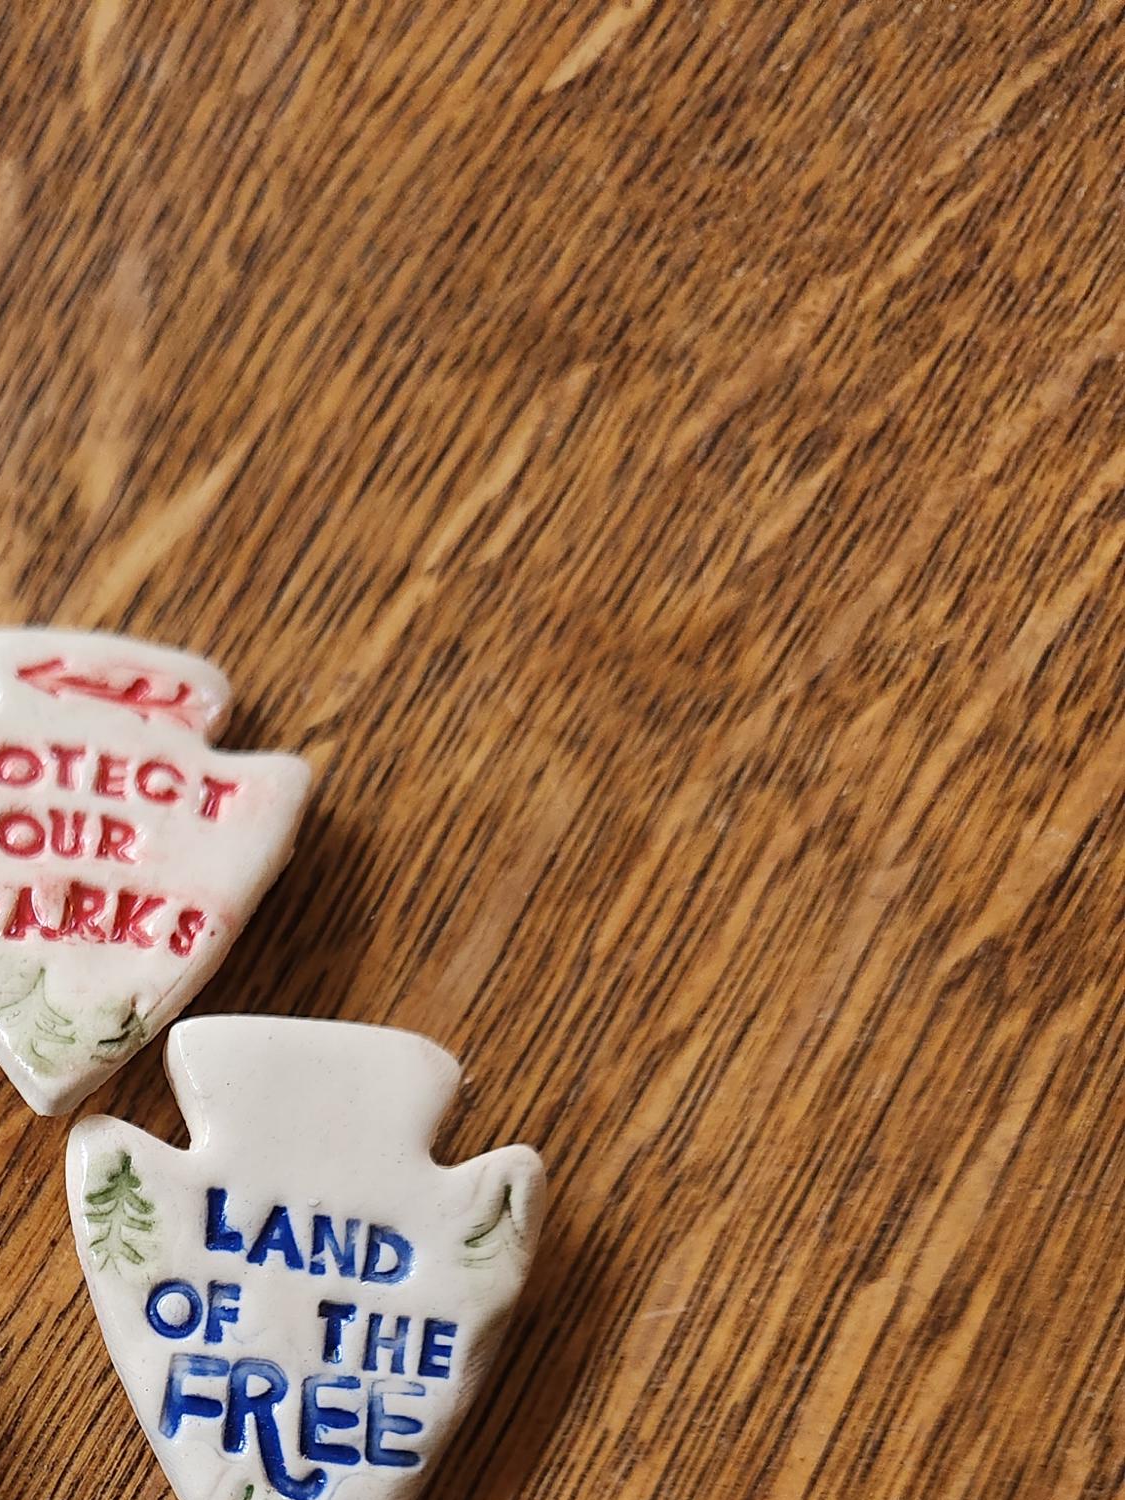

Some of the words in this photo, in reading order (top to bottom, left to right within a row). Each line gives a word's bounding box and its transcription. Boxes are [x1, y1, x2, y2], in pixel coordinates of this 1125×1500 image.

[206, 1189, 416, 1284] LAND
[146, 1281, 241, 1343] OF
[319, 1302, 458, 1378] THE
